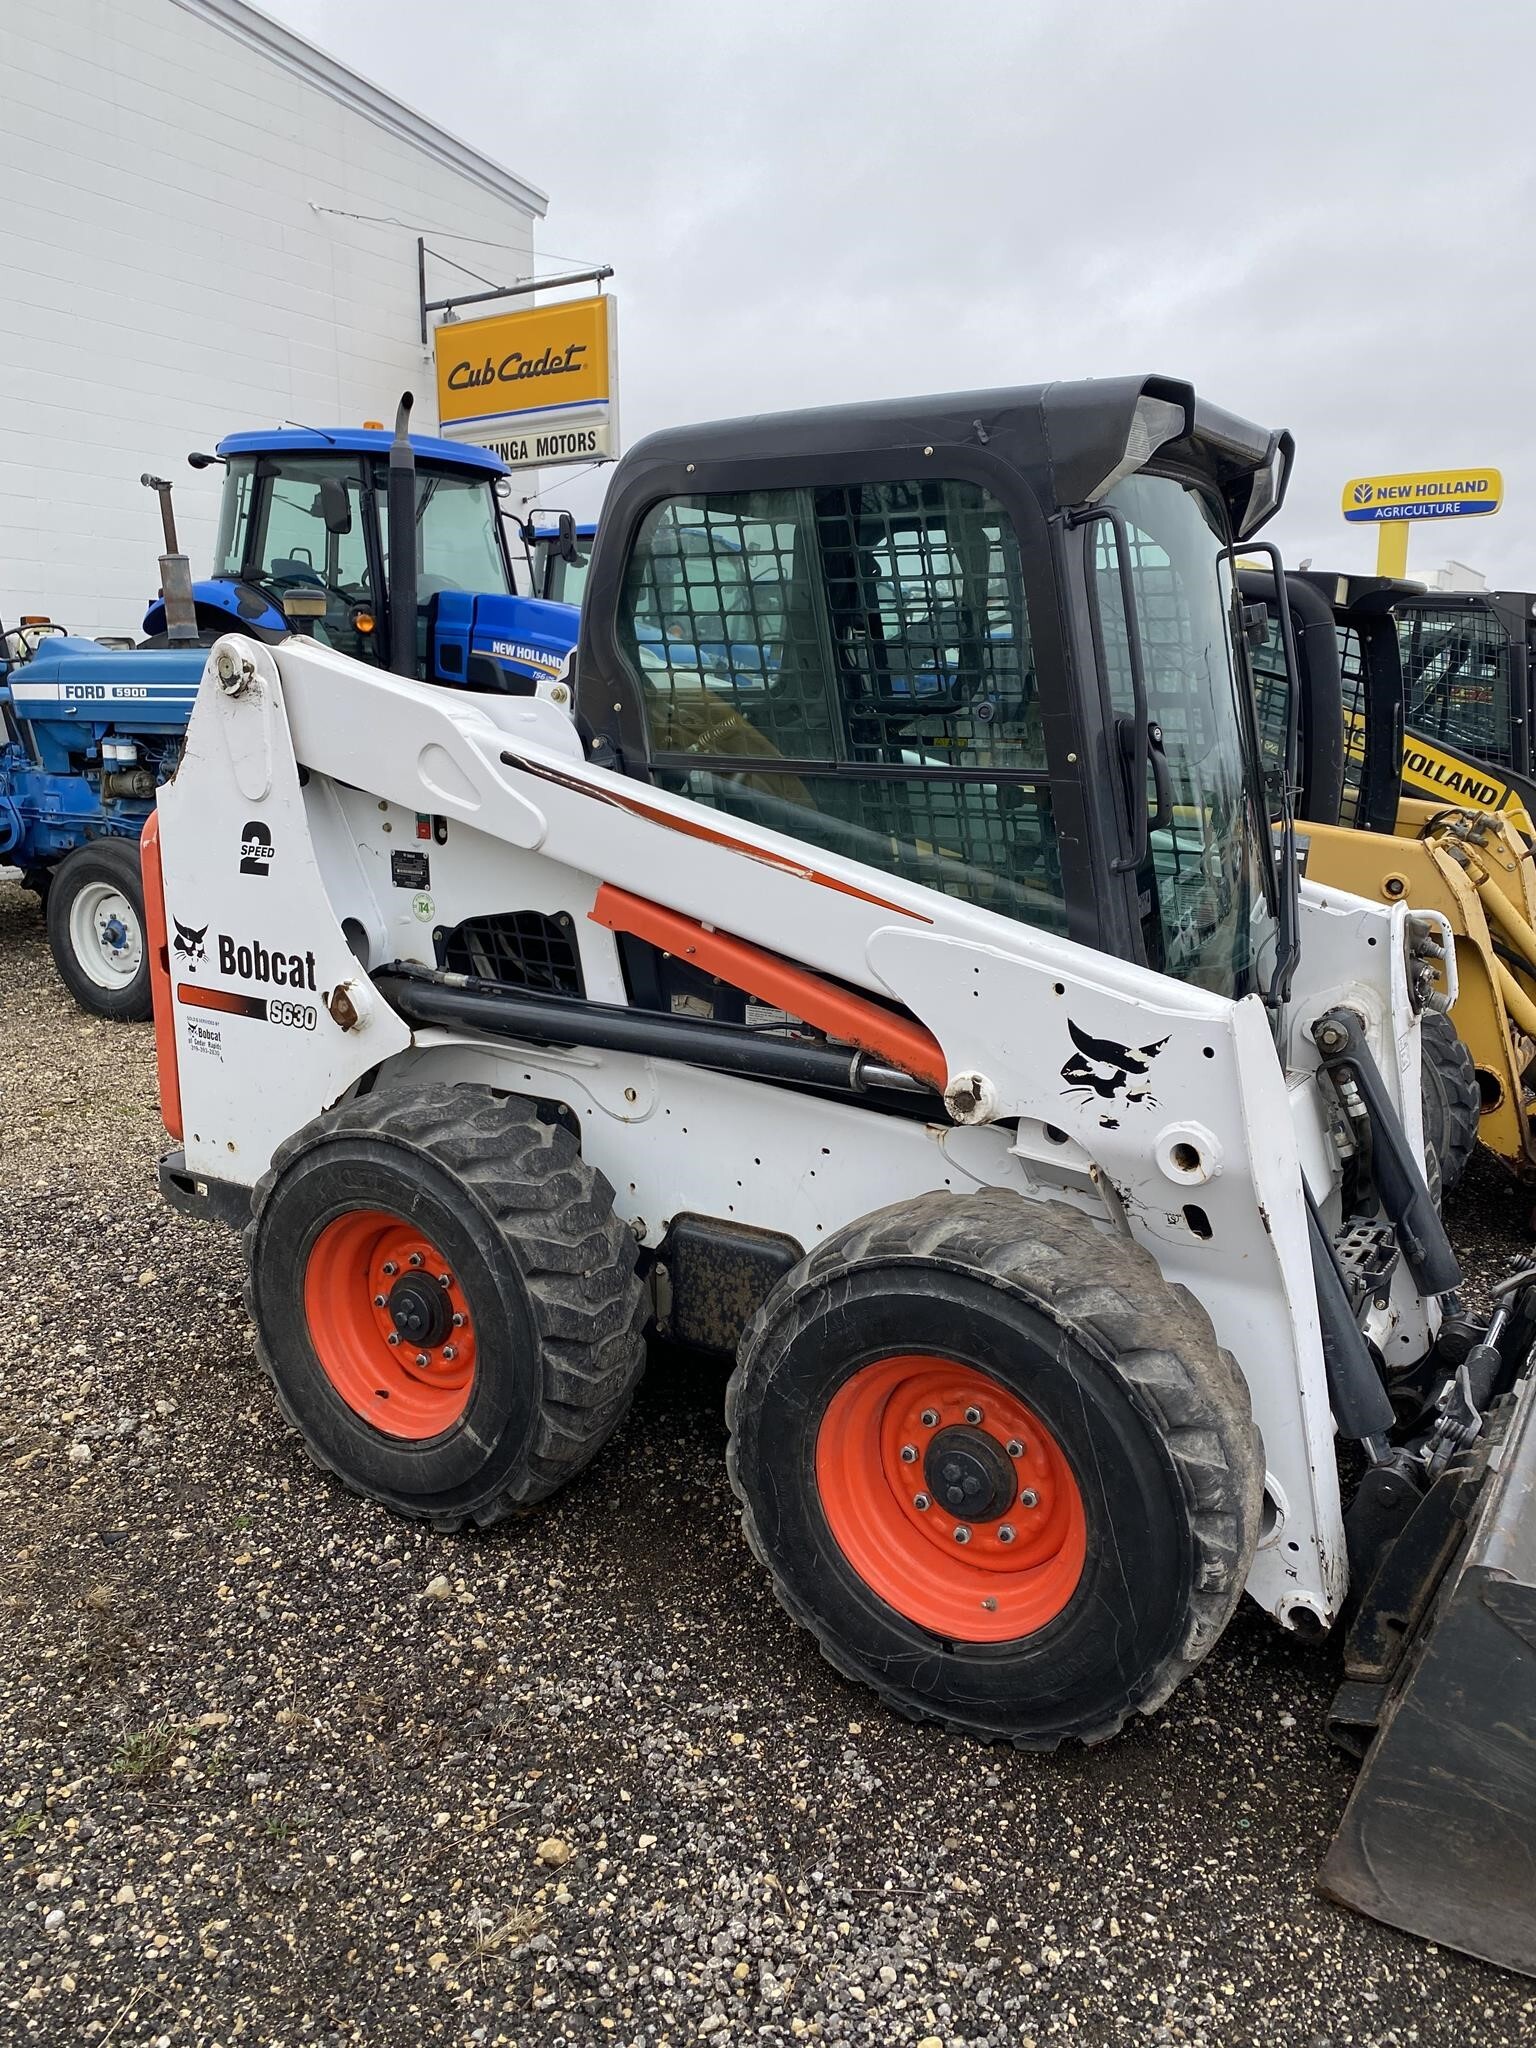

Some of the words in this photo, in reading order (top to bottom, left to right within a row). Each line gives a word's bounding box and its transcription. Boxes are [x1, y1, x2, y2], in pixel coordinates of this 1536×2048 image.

[447, 357, 495, 391] Cub
[497, 344, 587, 382] Cadet
[536, 430, 596, 457] MOTORS
[1376, 484, 1412, 500] NEW
[1415, 479, 1489, 497] HOLLAND
[1374, 501, 1461, 518] AGRICULTURE
[492, 641, 515, 657] NEW
[516, 645, 564, 669] HOLLAND
[65, 685, 105, 699] FORD
[115, 687, 148, 697] 5900
[239, 820, 272, 877] 2
[240, 844, 275, 859] SPEED
[217, 933, 317, 992] Bobcat
[269, 998, 318, 1031] S630
[198, 1027, 222, 1042] Bobcat
